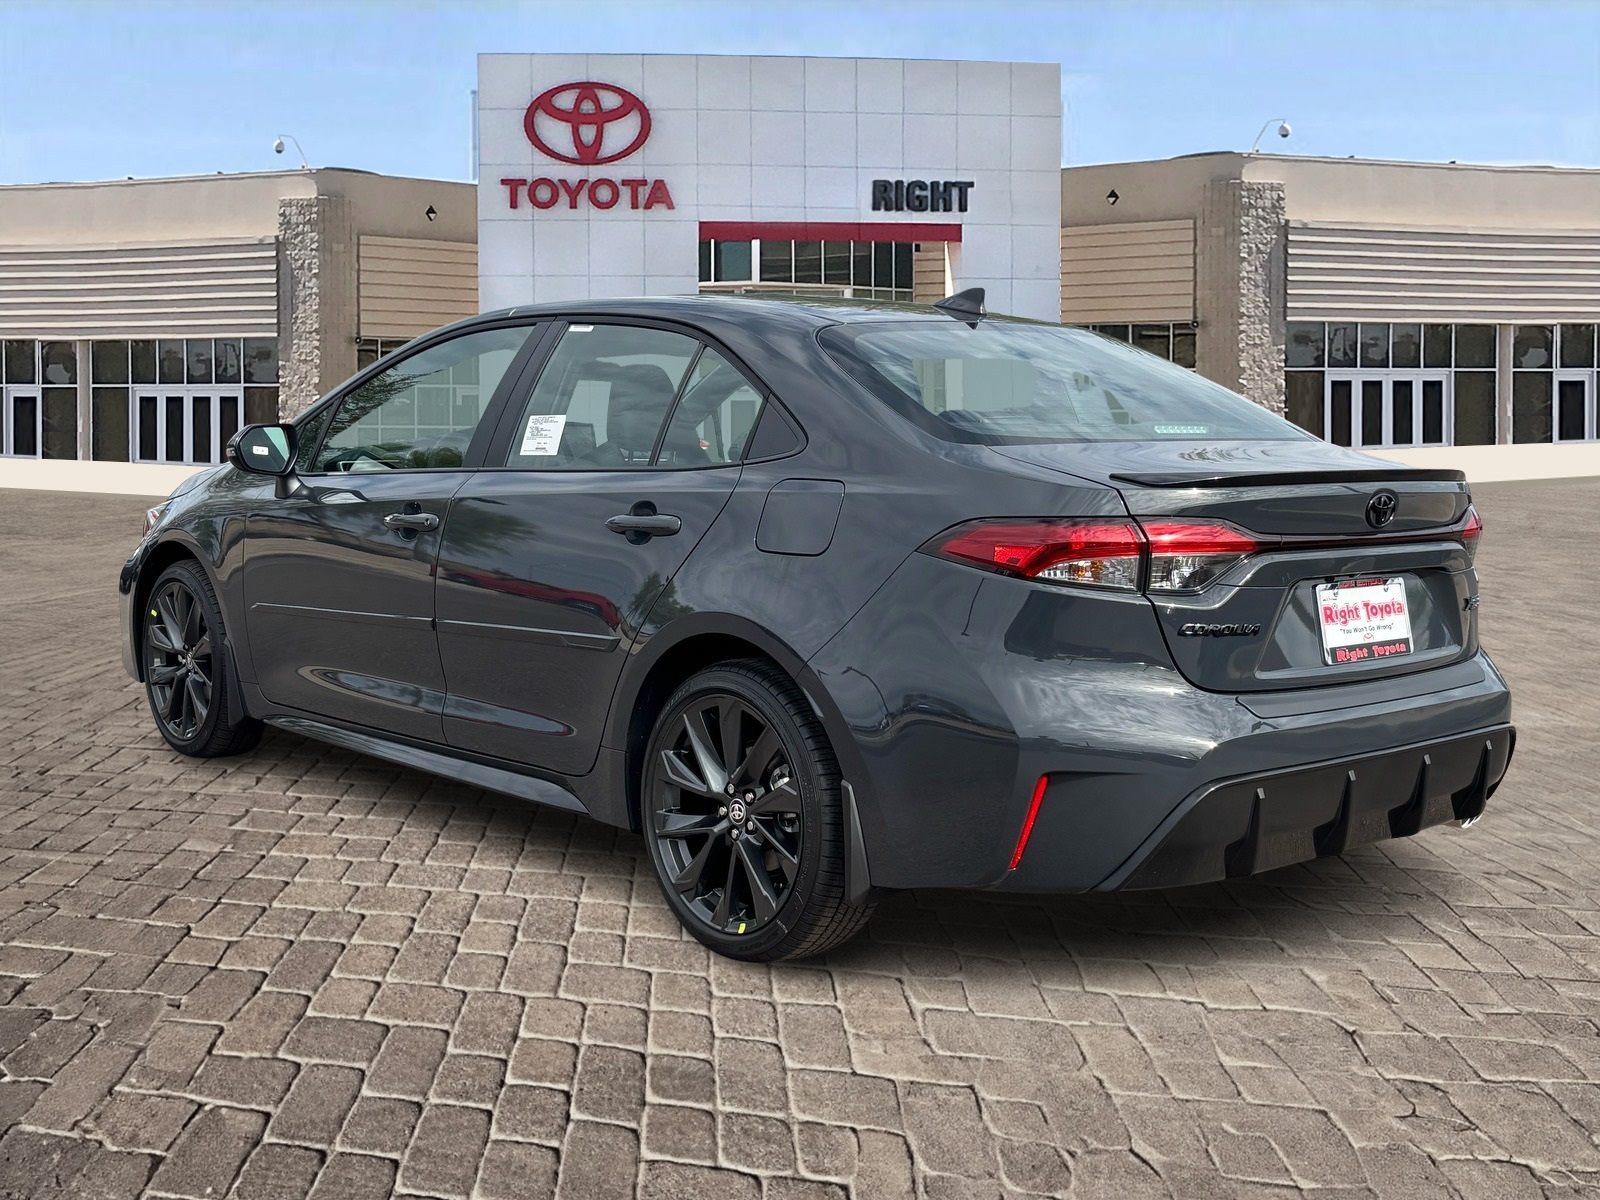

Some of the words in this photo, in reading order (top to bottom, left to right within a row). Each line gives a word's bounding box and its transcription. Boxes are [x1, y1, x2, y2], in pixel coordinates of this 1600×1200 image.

[500, 177, 675, 210] TOYOTA
[871, 179, 975, 212] RIGHT
[1323, 602, 1361, 625] Right
[1363, 599, 1404, 621] Toyota
[1178, 623, 1261, 638] COROLLA
[1336, 647, 1368, 662] Right
[1372, 642, 1407, 657] Toyota
